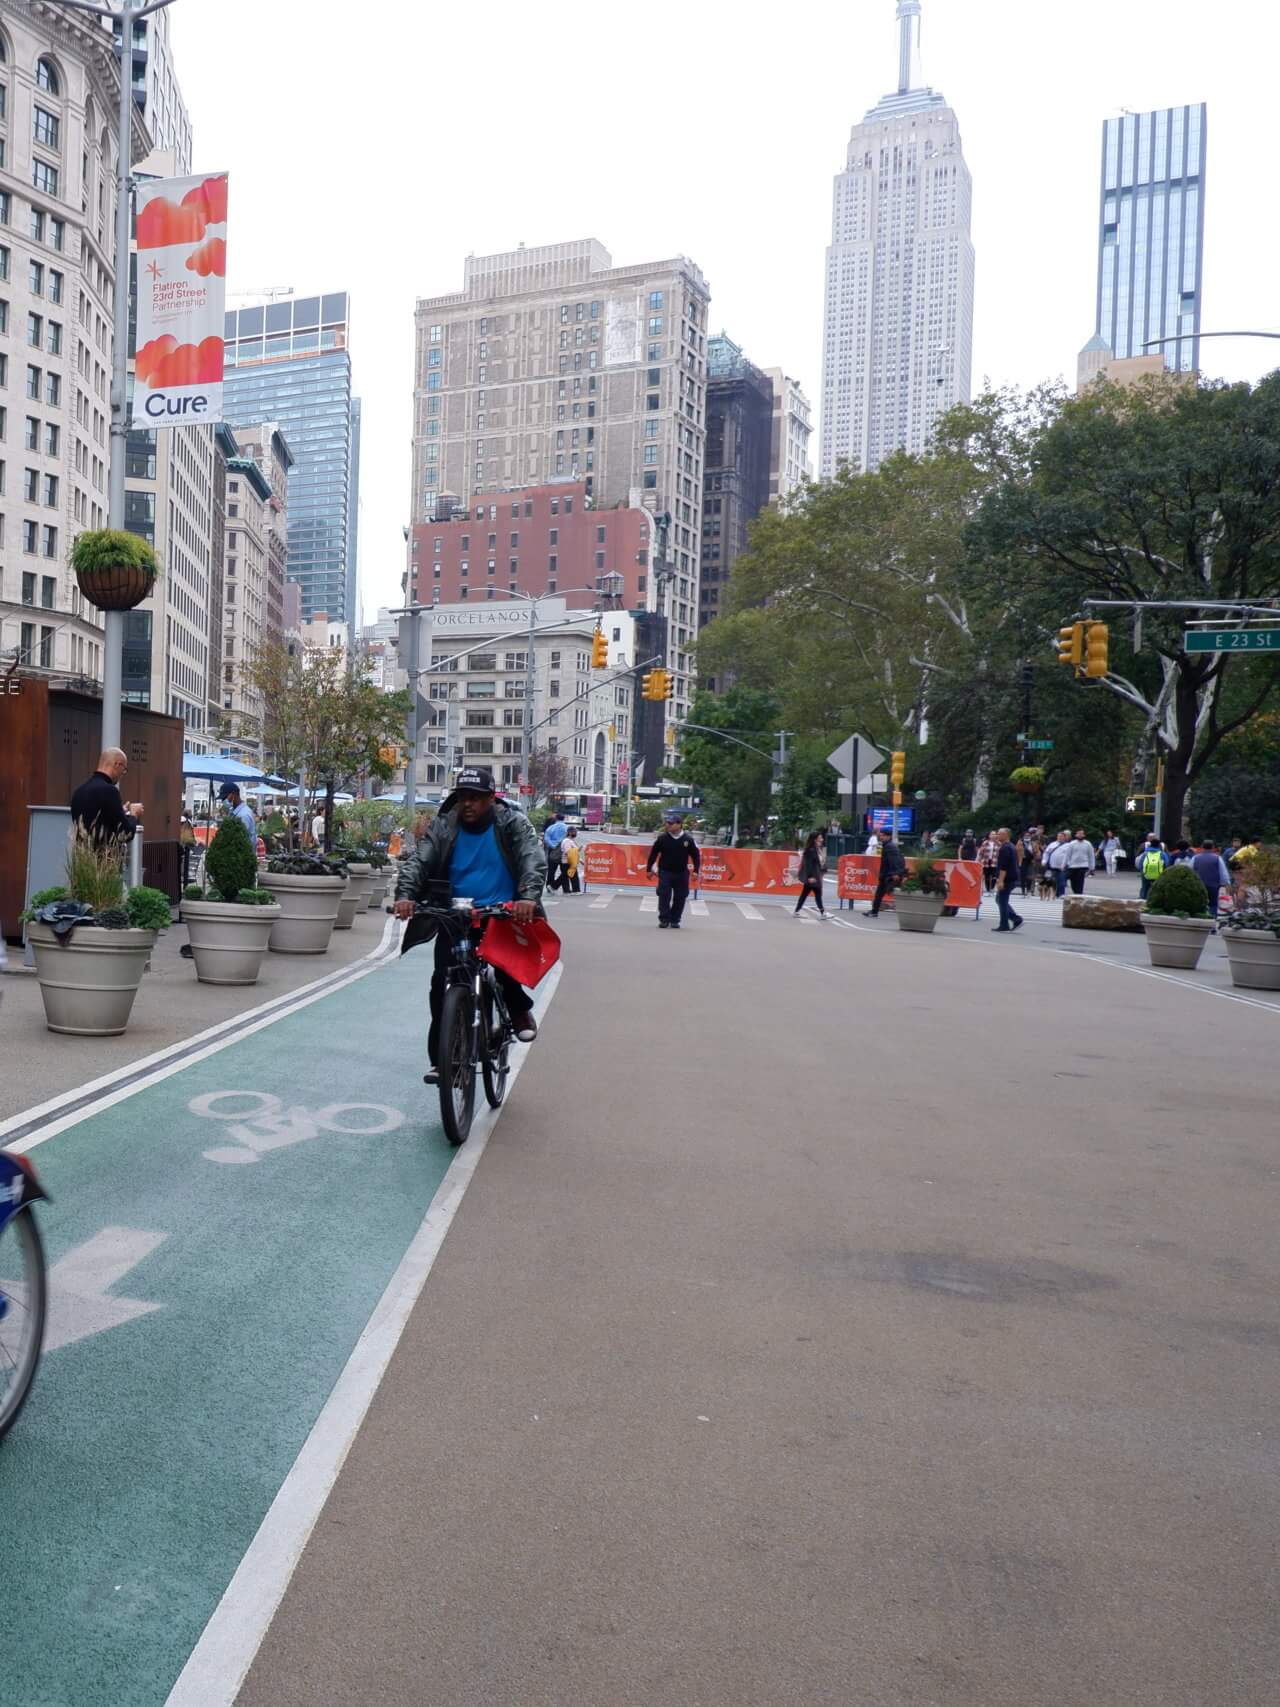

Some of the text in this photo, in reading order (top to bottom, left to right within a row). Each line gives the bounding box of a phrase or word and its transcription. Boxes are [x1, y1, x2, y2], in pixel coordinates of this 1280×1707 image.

[153, 281, 188, 292] Flatiron
[153, 288, 207, 302] 23rd Street
[153, 298, 206, 312] Partnership
[1215, 633, 1272, 647] E 23 St
